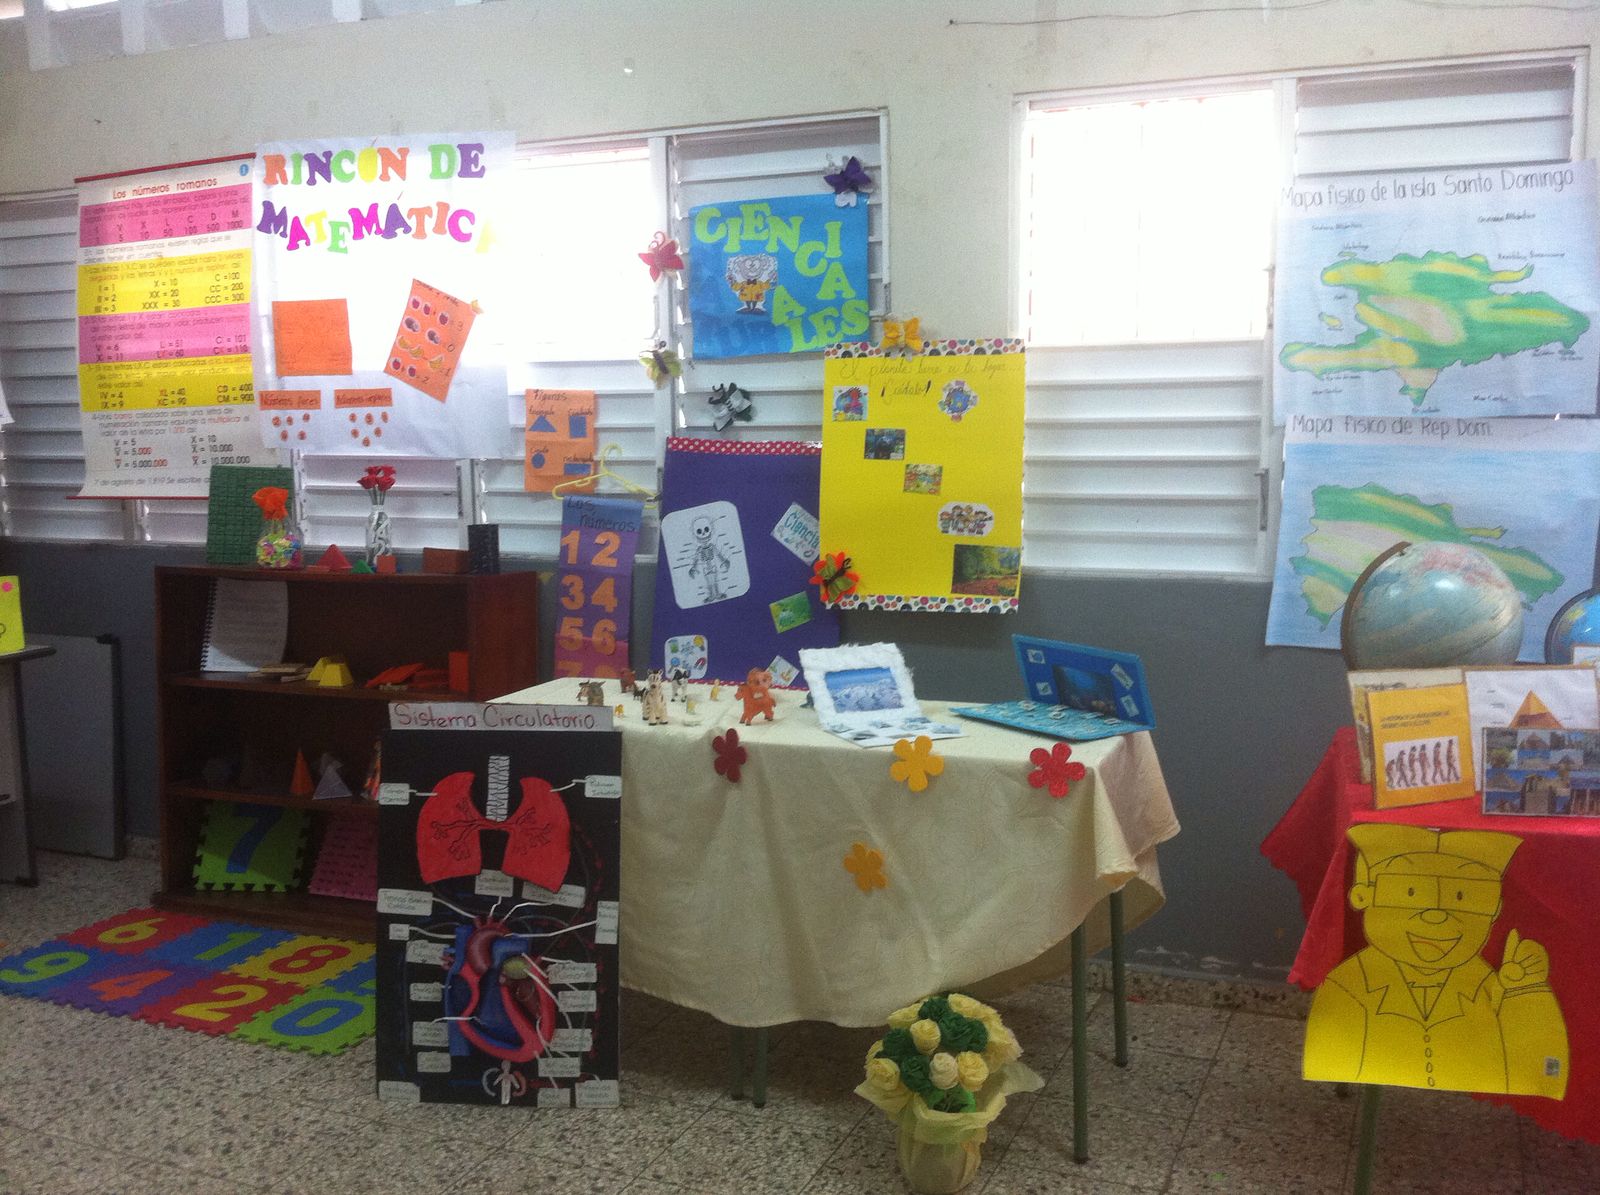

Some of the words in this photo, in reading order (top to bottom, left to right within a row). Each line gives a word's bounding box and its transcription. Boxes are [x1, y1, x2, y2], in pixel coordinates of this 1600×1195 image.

[427, 143, 486, 180] DE
[112, 190, 126, 199] Los
[132, 184, 170, 196] números
[176, 177, 218, 190] romanos
[1281, 186, 1323, 212] Mapa
[1371, 180, 1388, 201] de
[1393, 178, 1406, 199] la
[1443, 172, 1493, 196] Santo
[1501, 168, 1574, 193] Domingo
[141, 220, 148, 230] X
[186, 214, 194, 224] C
[210, 211, 217, 221] D
[231, 209, 239, 219] M
[163, 228, 173, 237] 50
[184, 225, 198, 235] 100
[206, 222, 220, 232] 500
[214, 273, 221, 282] C
[153, 280, 160, 288] X
[209, 284, 221, 293] CC
[231, 282, 244, 291] 200
[111, 294, 117, 302] 2
[149, 291, 160, 300] XX
[170, 288, 180, 297] 20
[204, 294, 222, 304] CCC
[231, 292, 245, 302] 300
[111, 304, 117, 312] 3
[142, 302, 159, 310] XXX
[172, 299, 181, 308] 30
[174, 349, 184, 358] 60
[239, 383, 253, 392] 400
[118, 391, 124, 399] 4
[217, 394, 231, 403] CM
[240, 393, 254, 403] 900
[118, 401, 124, 409] 9
[178, 397, 187, 406] 90
[1292, 416, 1334, 437] Mapa
[1391, 416, 1413, 435] de
[1420, 418, 1451, 438] Rep
[130, 438, 137, 447] 5
[190, 435, 198, 444] X
[207, 434, 217, 443] 10
[560, 530, 581, 565] 1
[591, 531, 621, 568] 2
[561, 574, 585, 610] 3
[591, 578, 618, 613] 4
[559, 617, 585, 651] 5
[591, 619, 617, 656] 6
[394, 705, 477, 728] Sistema
[482, 704, 595, 729] Circulatorio
[226, 803, 284, 873] 7
[268, 945, 351, 974] 8
[89, 969, 175, 1001] 4
[172, 984, 268, 1022] 2
